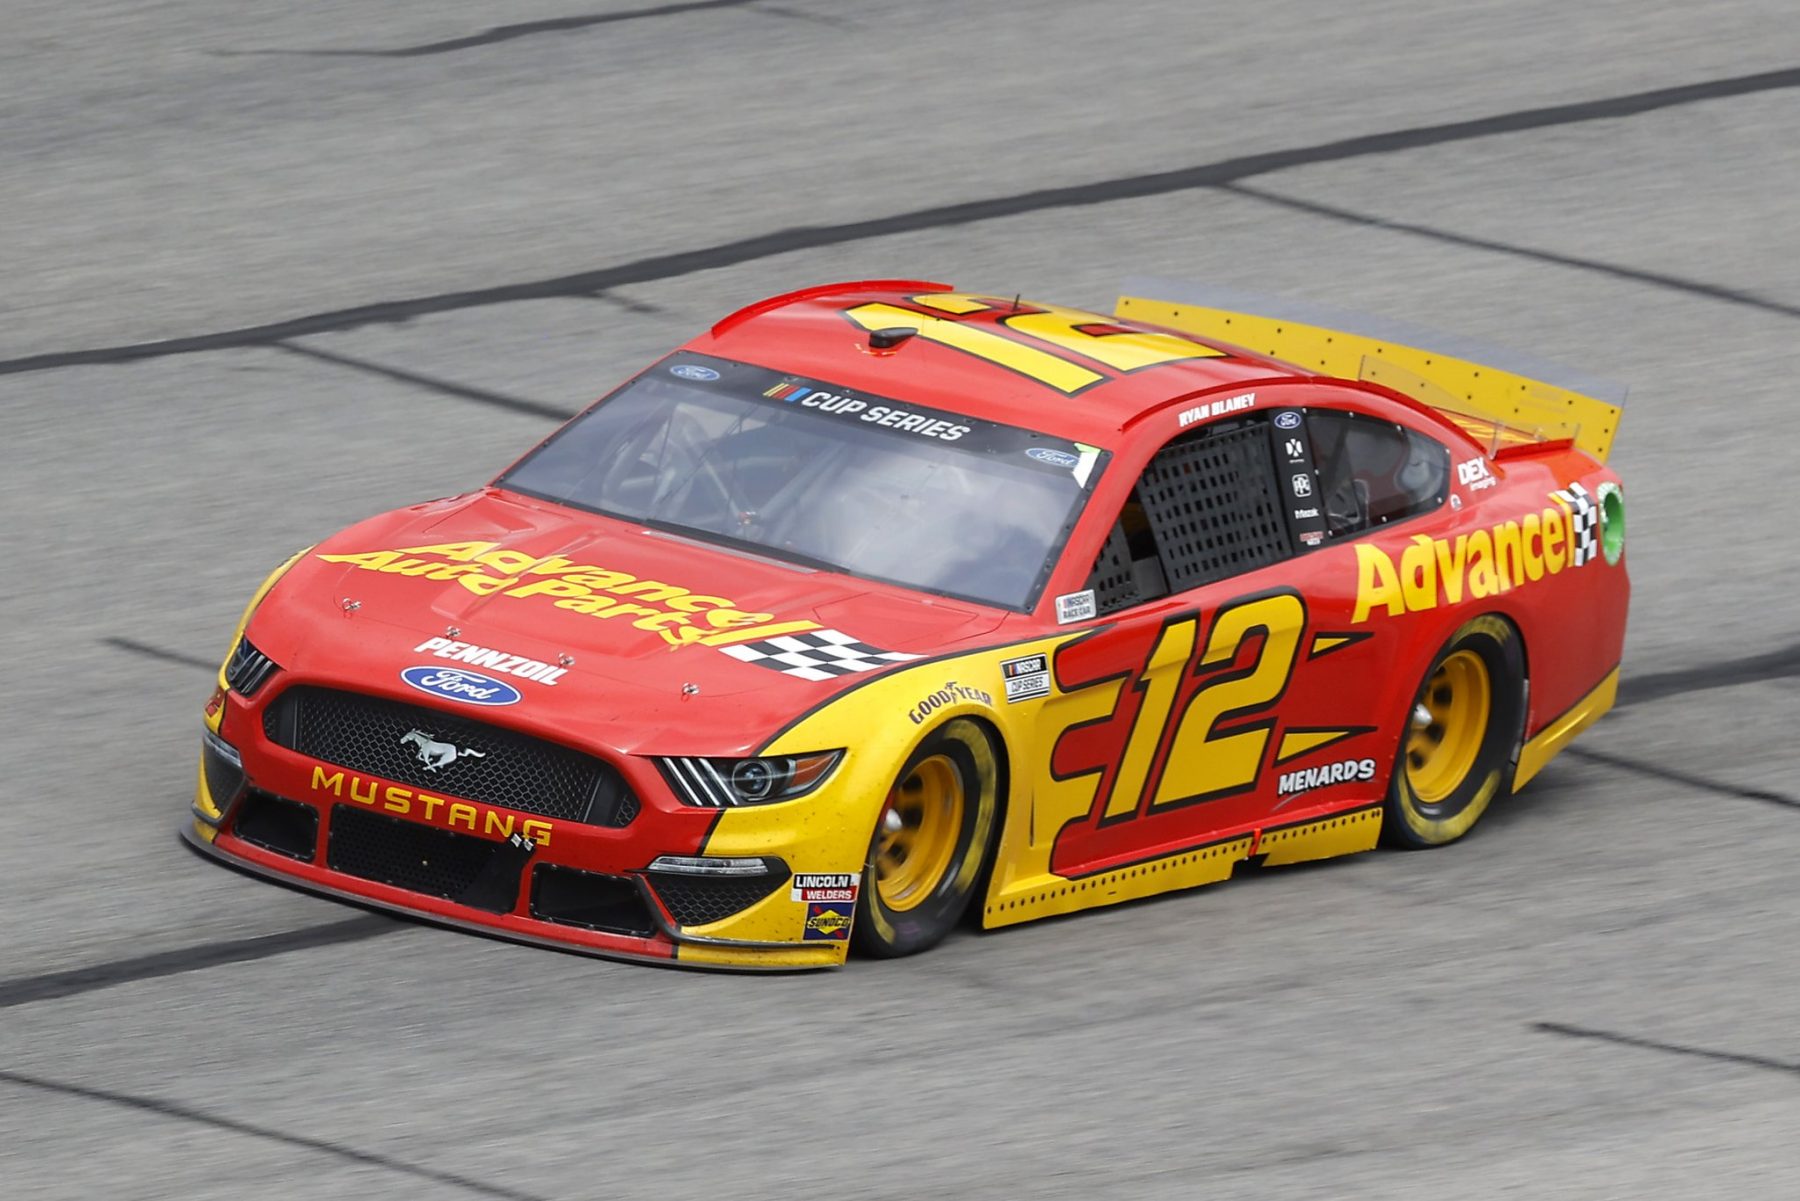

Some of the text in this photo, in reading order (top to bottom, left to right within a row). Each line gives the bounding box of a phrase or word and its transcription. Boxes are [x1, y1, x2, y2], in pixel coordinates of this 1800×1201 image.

[801, 390, 971, 442] CUP SERIES
[1178, 393, 1256, 427] RYAN BLANEY
[1035, 450, 1076, 466] Ford
[1457, 456, 1490, 486] DEX
[394, 540, 775, 629] Advance
[1351, 506, 1567, 625] Advance
[315, 550, 724, 649] Auto Parts
[413, 636, 569, 686] PENNZOIL
[420, 669, 501, 701] Ford
[1097, 586, 1307, 829] 12
[1278, 758, 1376, 797] MENARDS
[311, 765, 554, 847] MUSTANG
[795, 875, 849, 888] LINCOLN
[806, 890, 852, 900] WELDERS
[807, 917, 850, 928] SUNOCO
